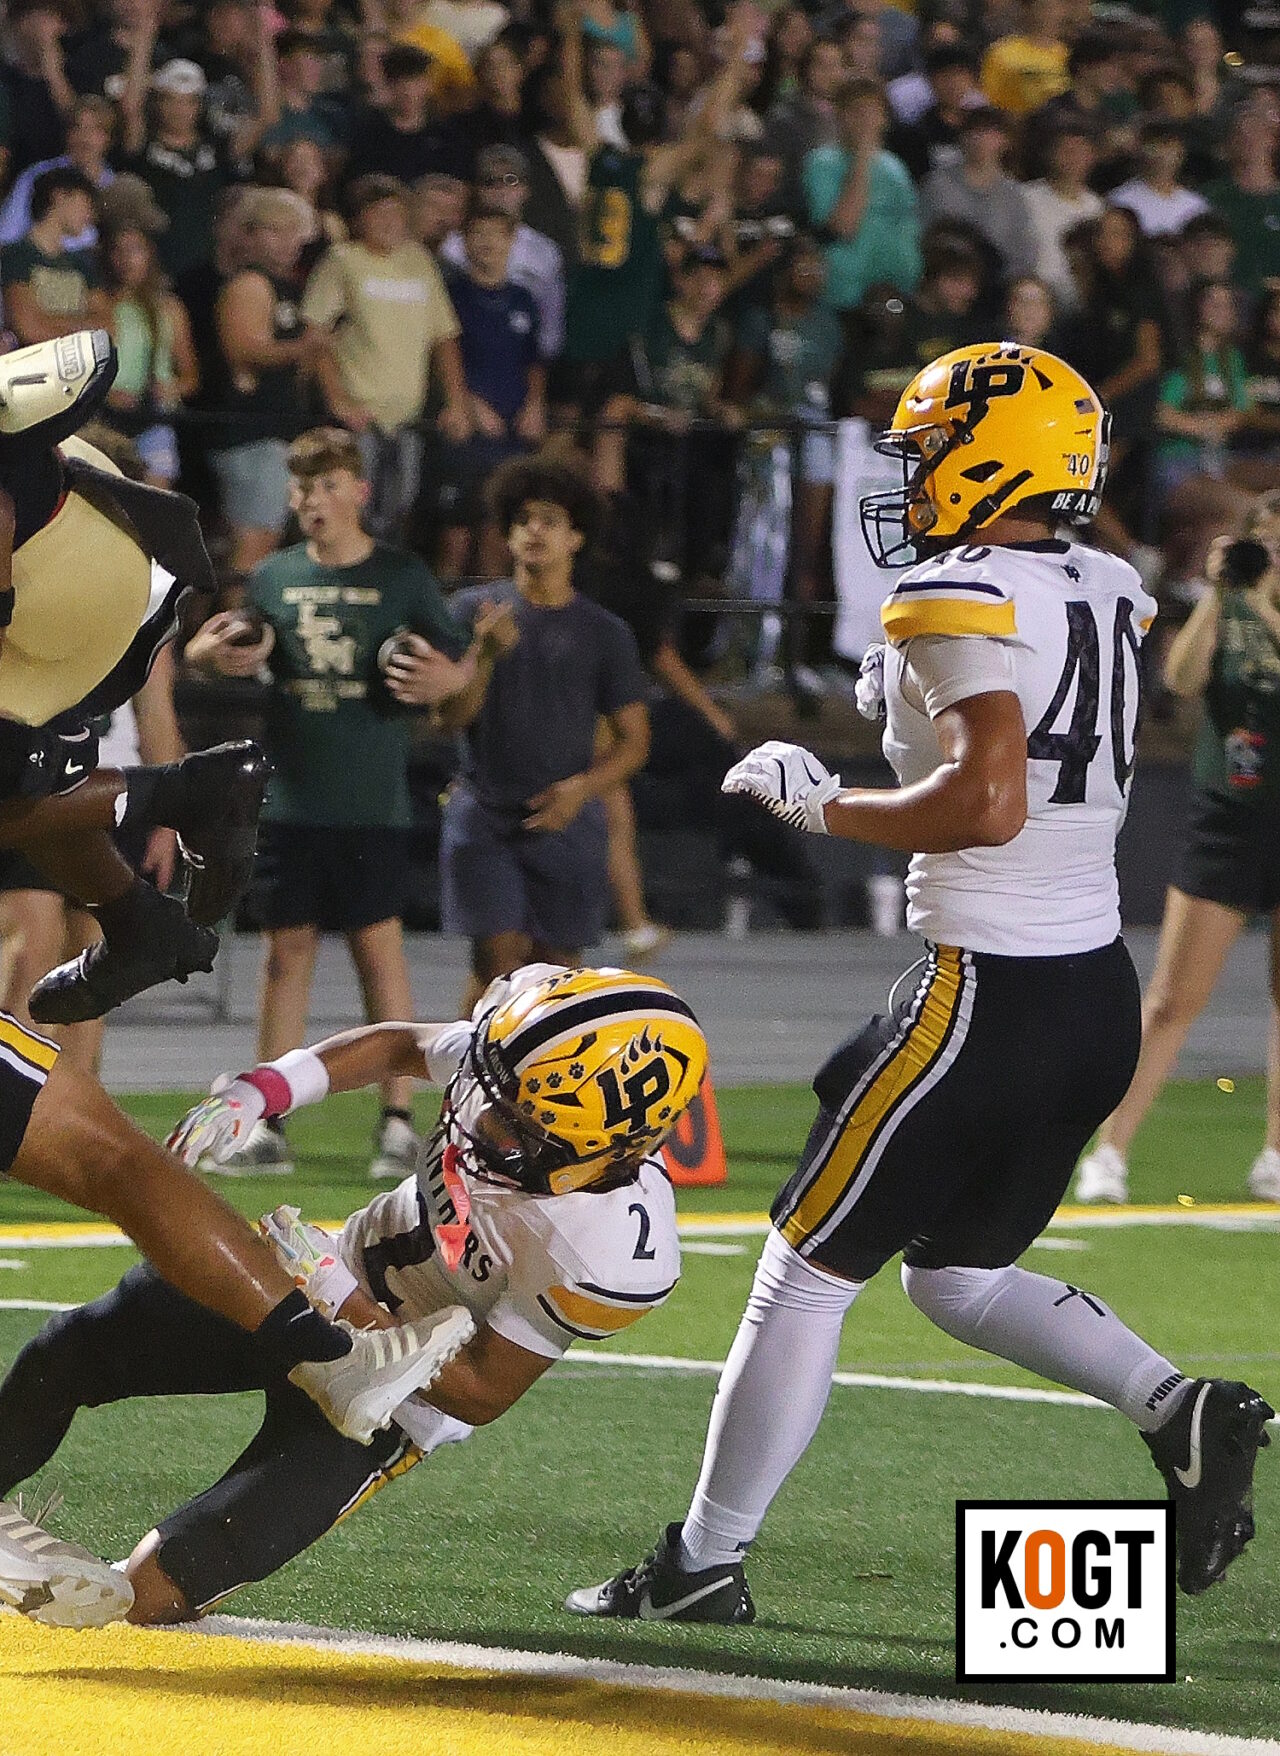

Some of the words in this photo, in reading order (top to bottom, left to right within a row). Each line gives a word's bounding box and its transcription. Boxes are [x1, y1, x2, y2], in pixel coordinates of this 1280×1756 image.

[944, 358, 1026, 424] LP
[1067, 454, 1089, 476] 40
[1051, 492, 1075, 510] BE
[1074, 493, 1087, 512] A
[1027, 596, 1143, 804] 40
[595, 1056, 670, 1133] LP
[628, 1203, 656, 1260] 2
